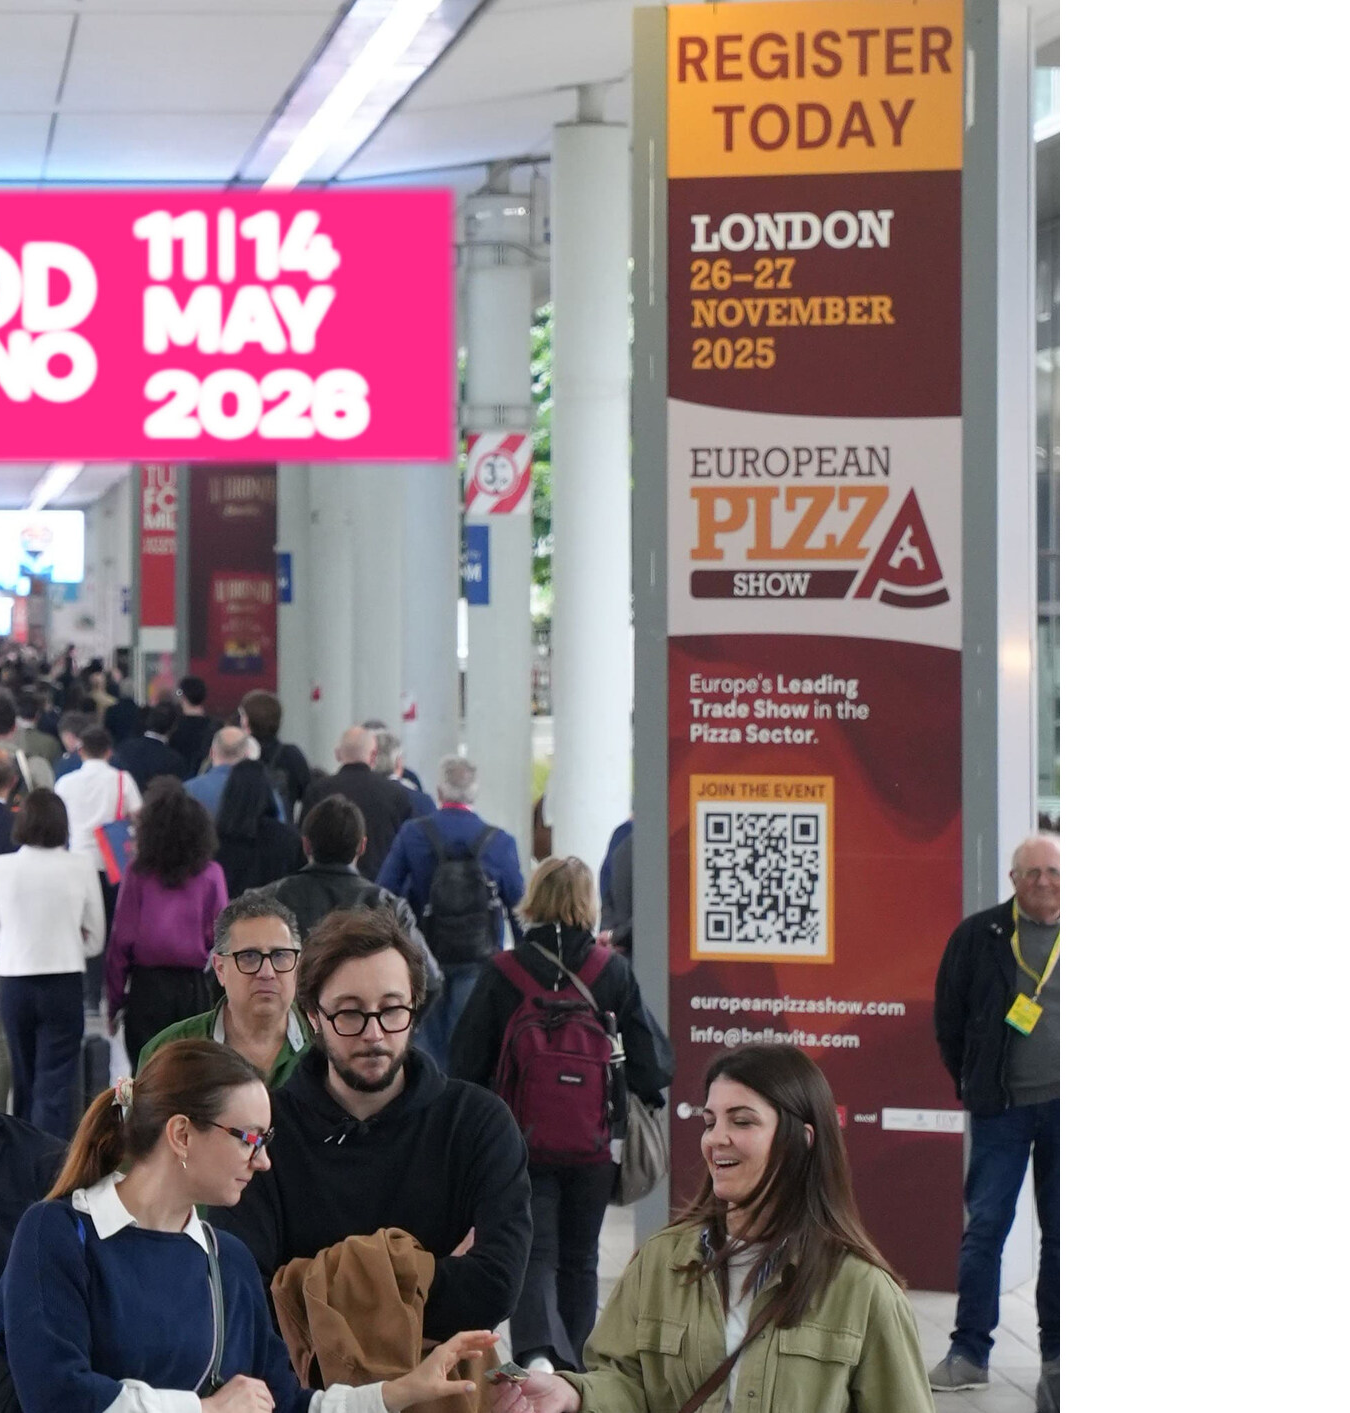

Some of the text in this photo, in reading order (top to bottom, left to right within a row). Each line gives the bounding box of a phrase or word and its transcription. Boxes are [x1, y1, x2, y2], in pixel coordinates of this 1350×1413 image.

[677, 26, 954, 83] REGISTER
[713, 99, 915, 152] TODAY
[690, 210, 894, 252] LONDON
[143, 285, 336, 355] MAY
[690, 296, 894, 328] NOVEMBER
[692, 338, 776, 370] 2025
[143, 368, 370, 440] 2026
[690, 447, 891, 479] EUROPEAN
[733, 572, 811, 598] SHOW
[689, 673, 859, 700] Europe's Leading
[689, 697, 870, 720] Trade Show in the
[689, 723, 819, 744] Pizza Sector.
[698, 783, 827, 799] JOIN THE EVENT
[690, 995, 906, 1016] europeanpizzashow.com
